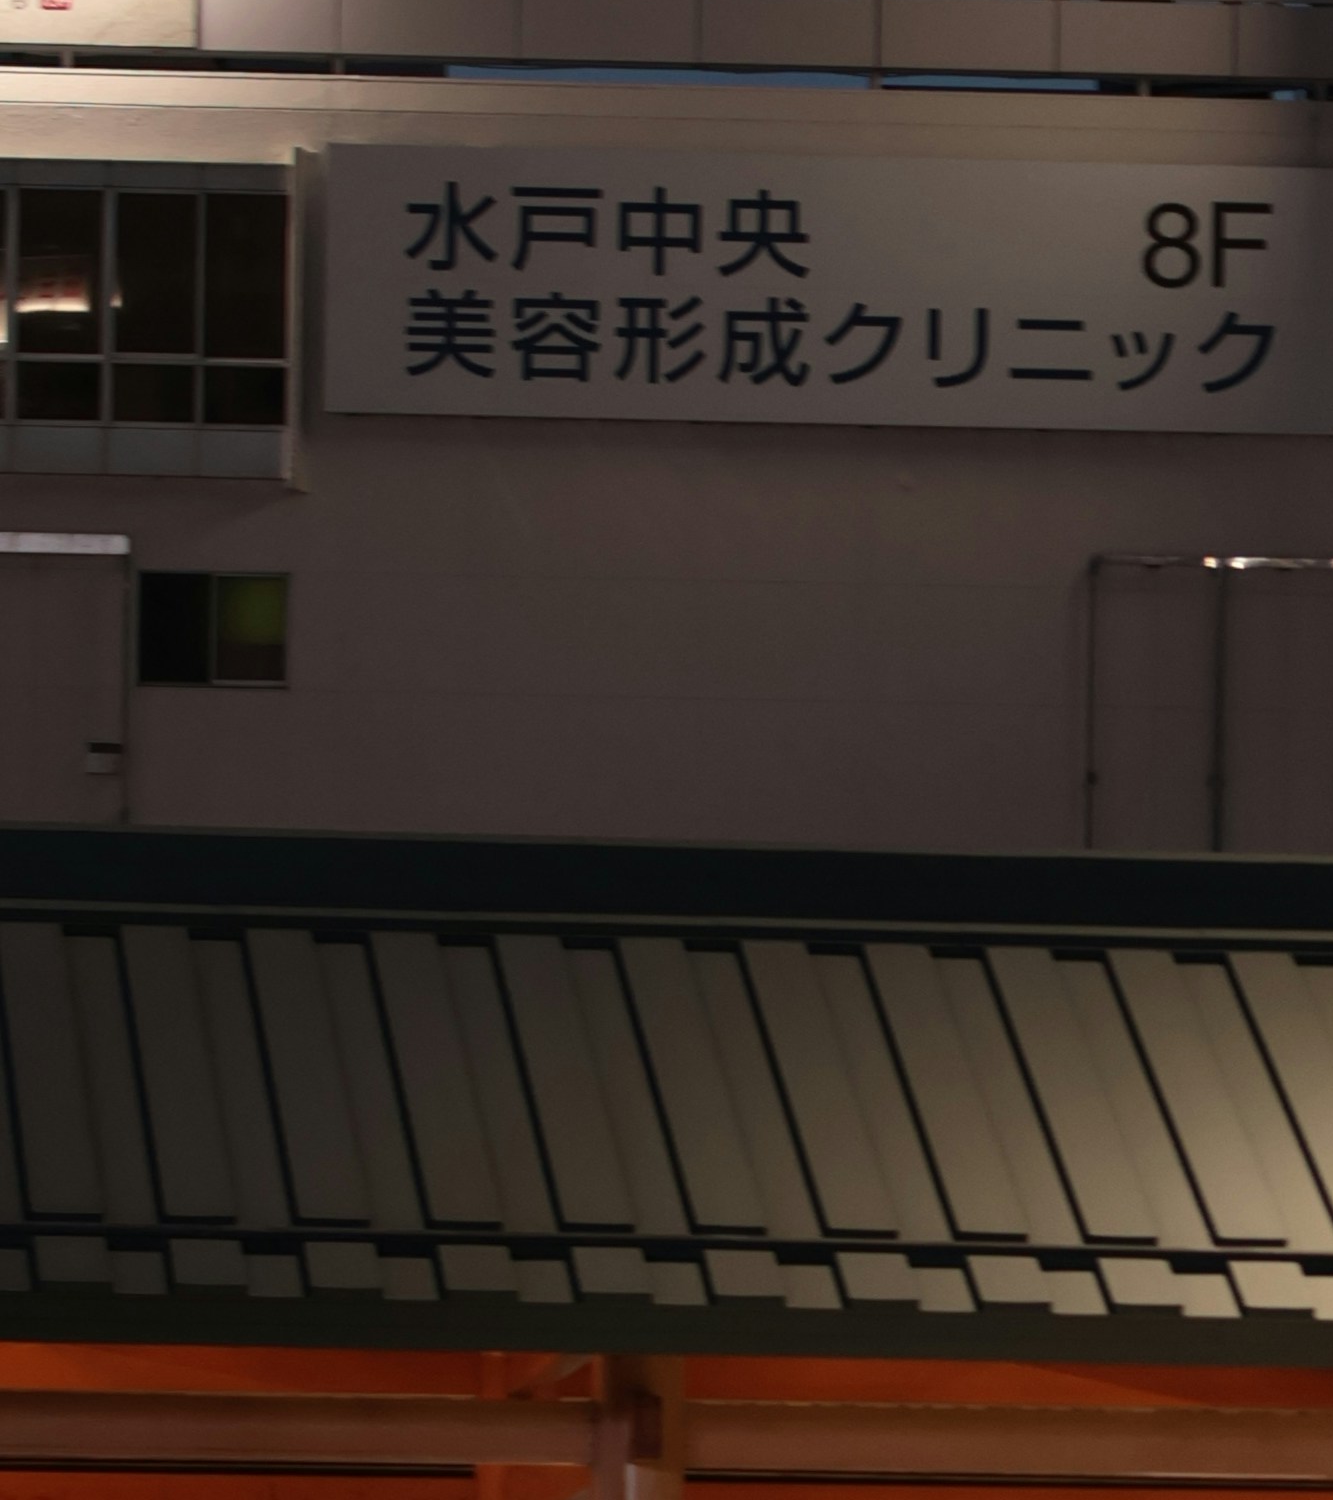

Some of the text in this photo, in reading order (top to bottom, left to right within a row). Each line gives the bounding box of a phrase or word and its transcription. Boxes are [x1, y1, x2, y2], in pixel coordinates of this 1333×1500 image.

[405, 182, 1274, 288] 水戸中央 8F
[405, 288, 1276, 394] 美容形成クリニック
